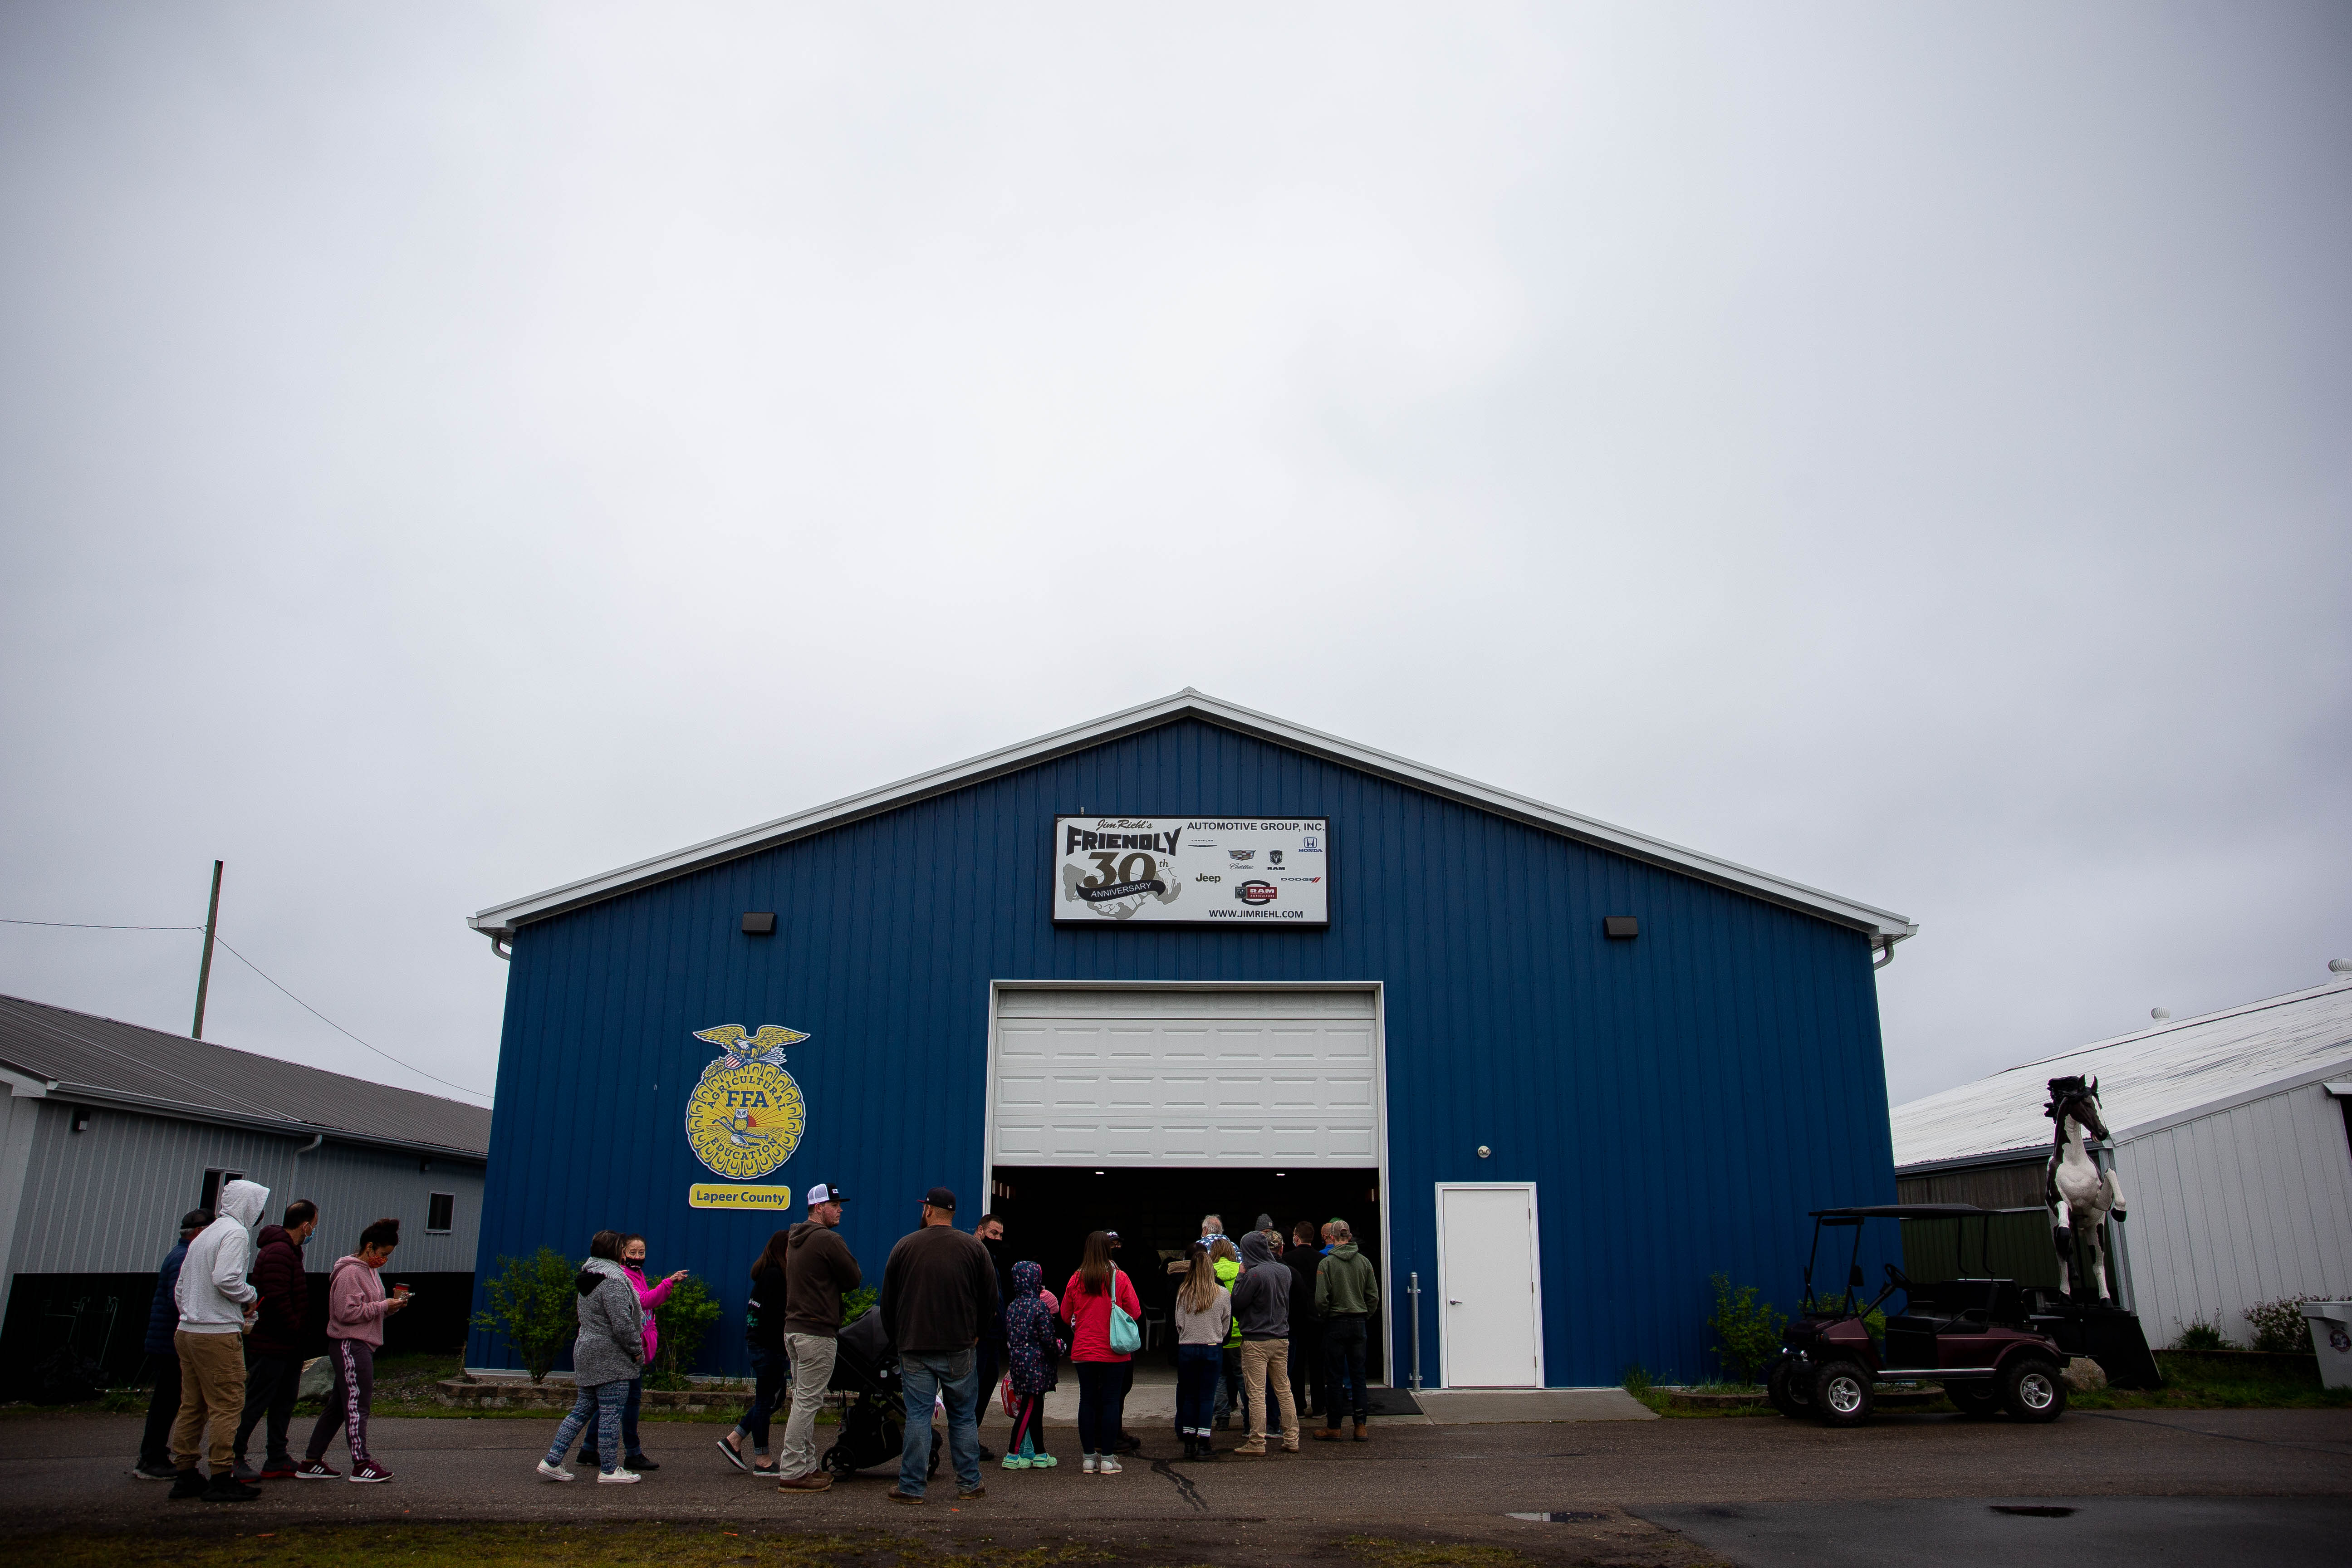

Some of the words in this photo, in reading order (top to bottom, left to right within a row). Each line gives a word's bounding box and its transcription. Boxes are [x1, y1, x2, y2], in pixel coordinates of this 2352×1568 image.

[1096, 819, 1115, 831] Jim
[1117, 819, 1153, 829] Riehl's
[1187, 822, 1257, 830] AUTOMOTIVE
[1260, 823, 1301, 832] GROUP,
[1066, 824, 1182, 857] FRIENDLY
[1196, 873, 1221, 884] Jeep
[1091, 882, 1152, 898] ANNIVERSARY
[1209, 910, 1303, 918] WWW.JIMRIEHL.COM
[706, 1075, 787, 1112] AGRICULTURAL
[725, 1090, 769, 1107] FFA
[710, 1137, 779, 1160] EDUCATION
[696, 1191, 738, 1203] Lapeer
[741, 1191, 785, 1205] County
